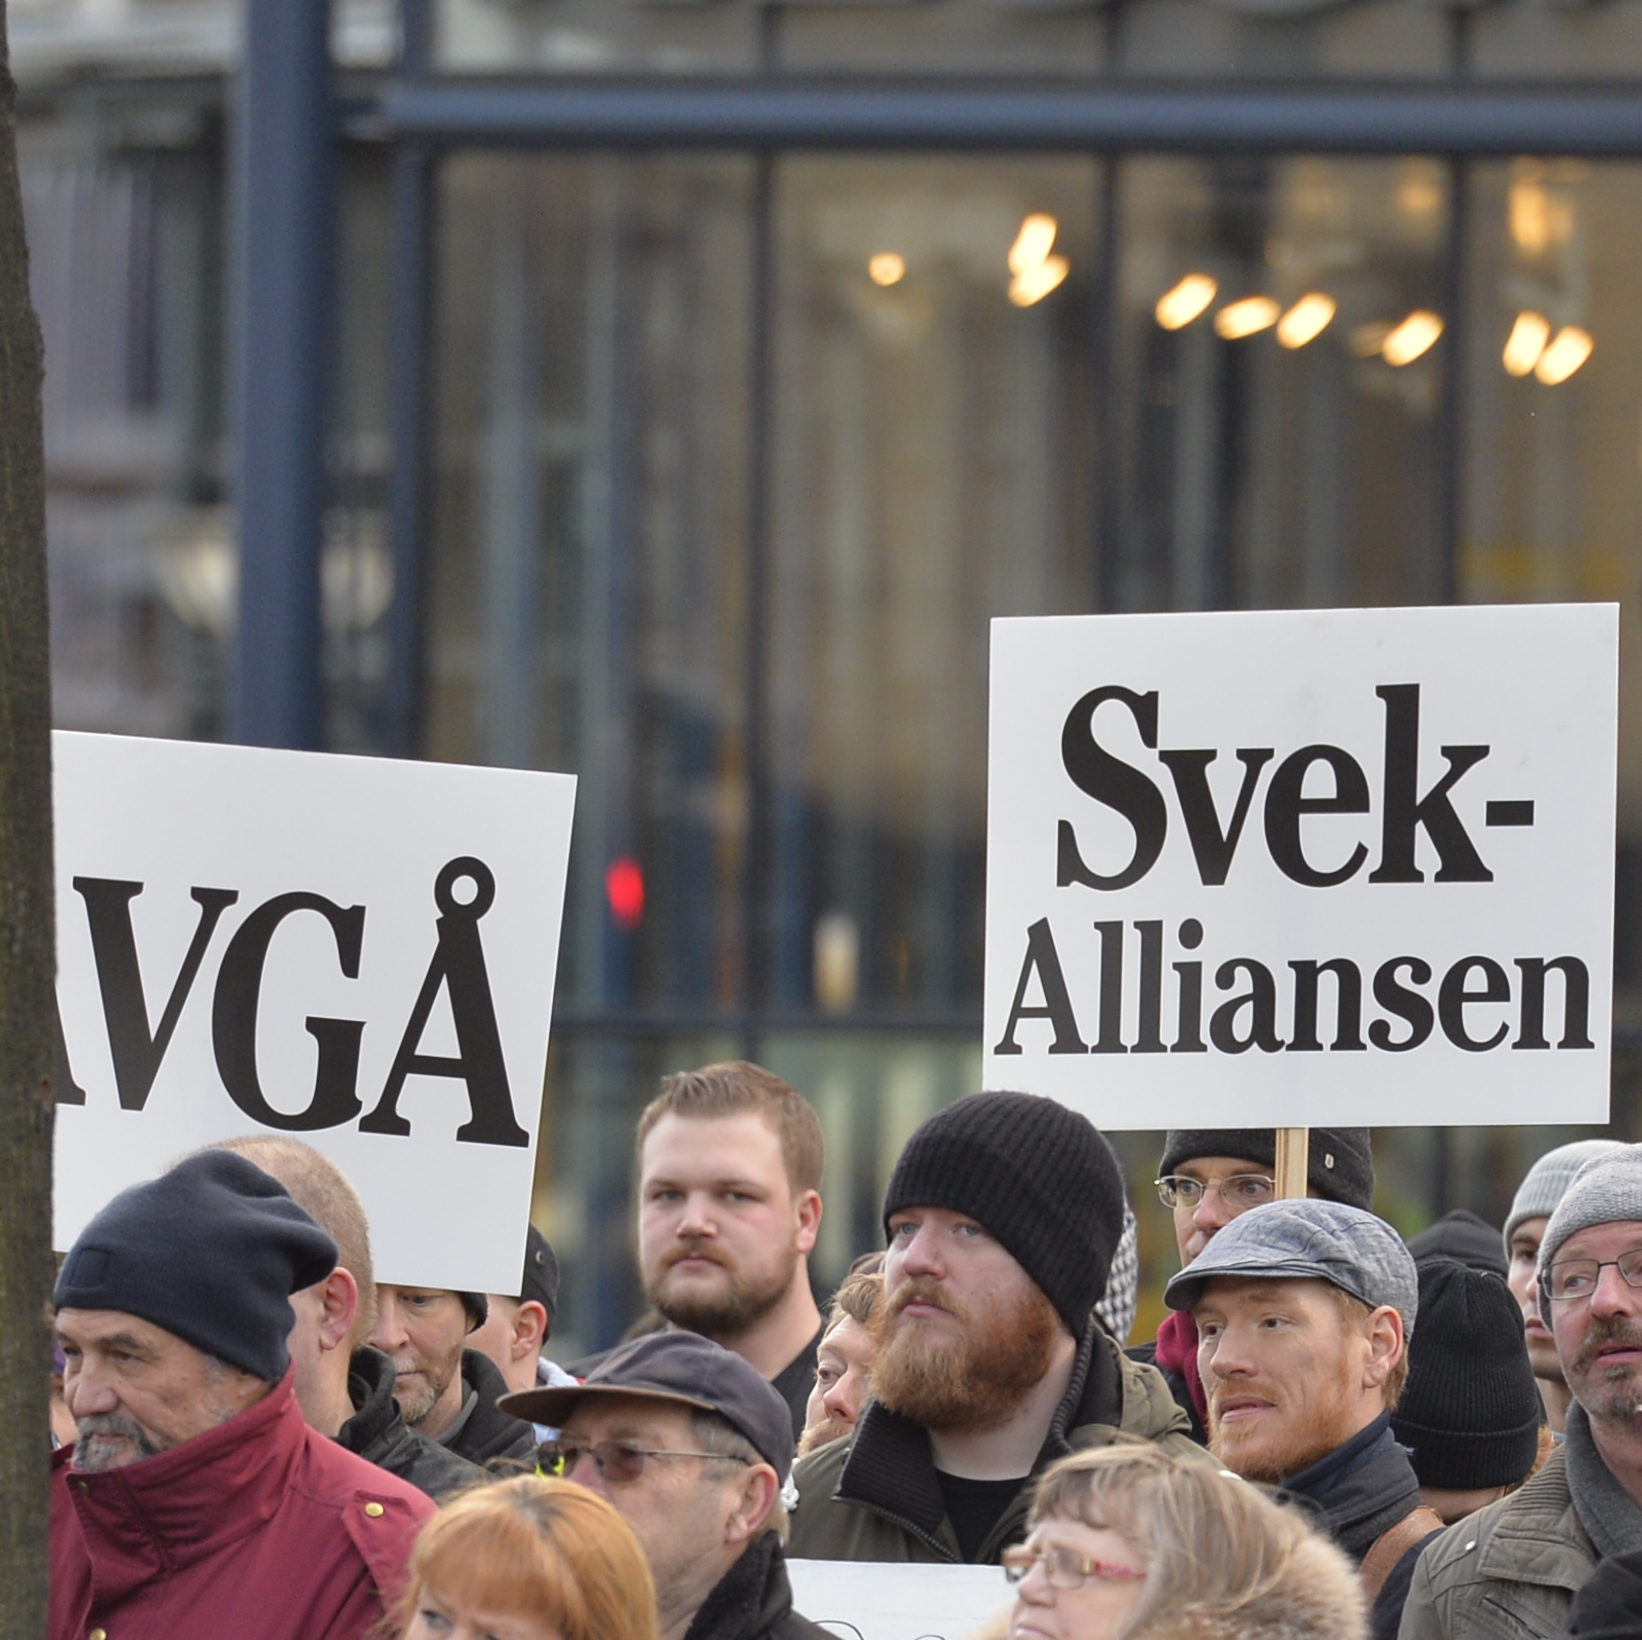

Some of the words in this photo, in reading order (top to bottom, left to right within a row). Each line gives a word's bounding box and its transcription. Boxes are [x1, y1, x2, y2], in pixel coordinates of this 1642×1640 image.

[1057, 684, 1534, 891] Svek-
[55, 856, 529, 1148] VGÅ
[997, 918, 1594, 1054] Alliansen
